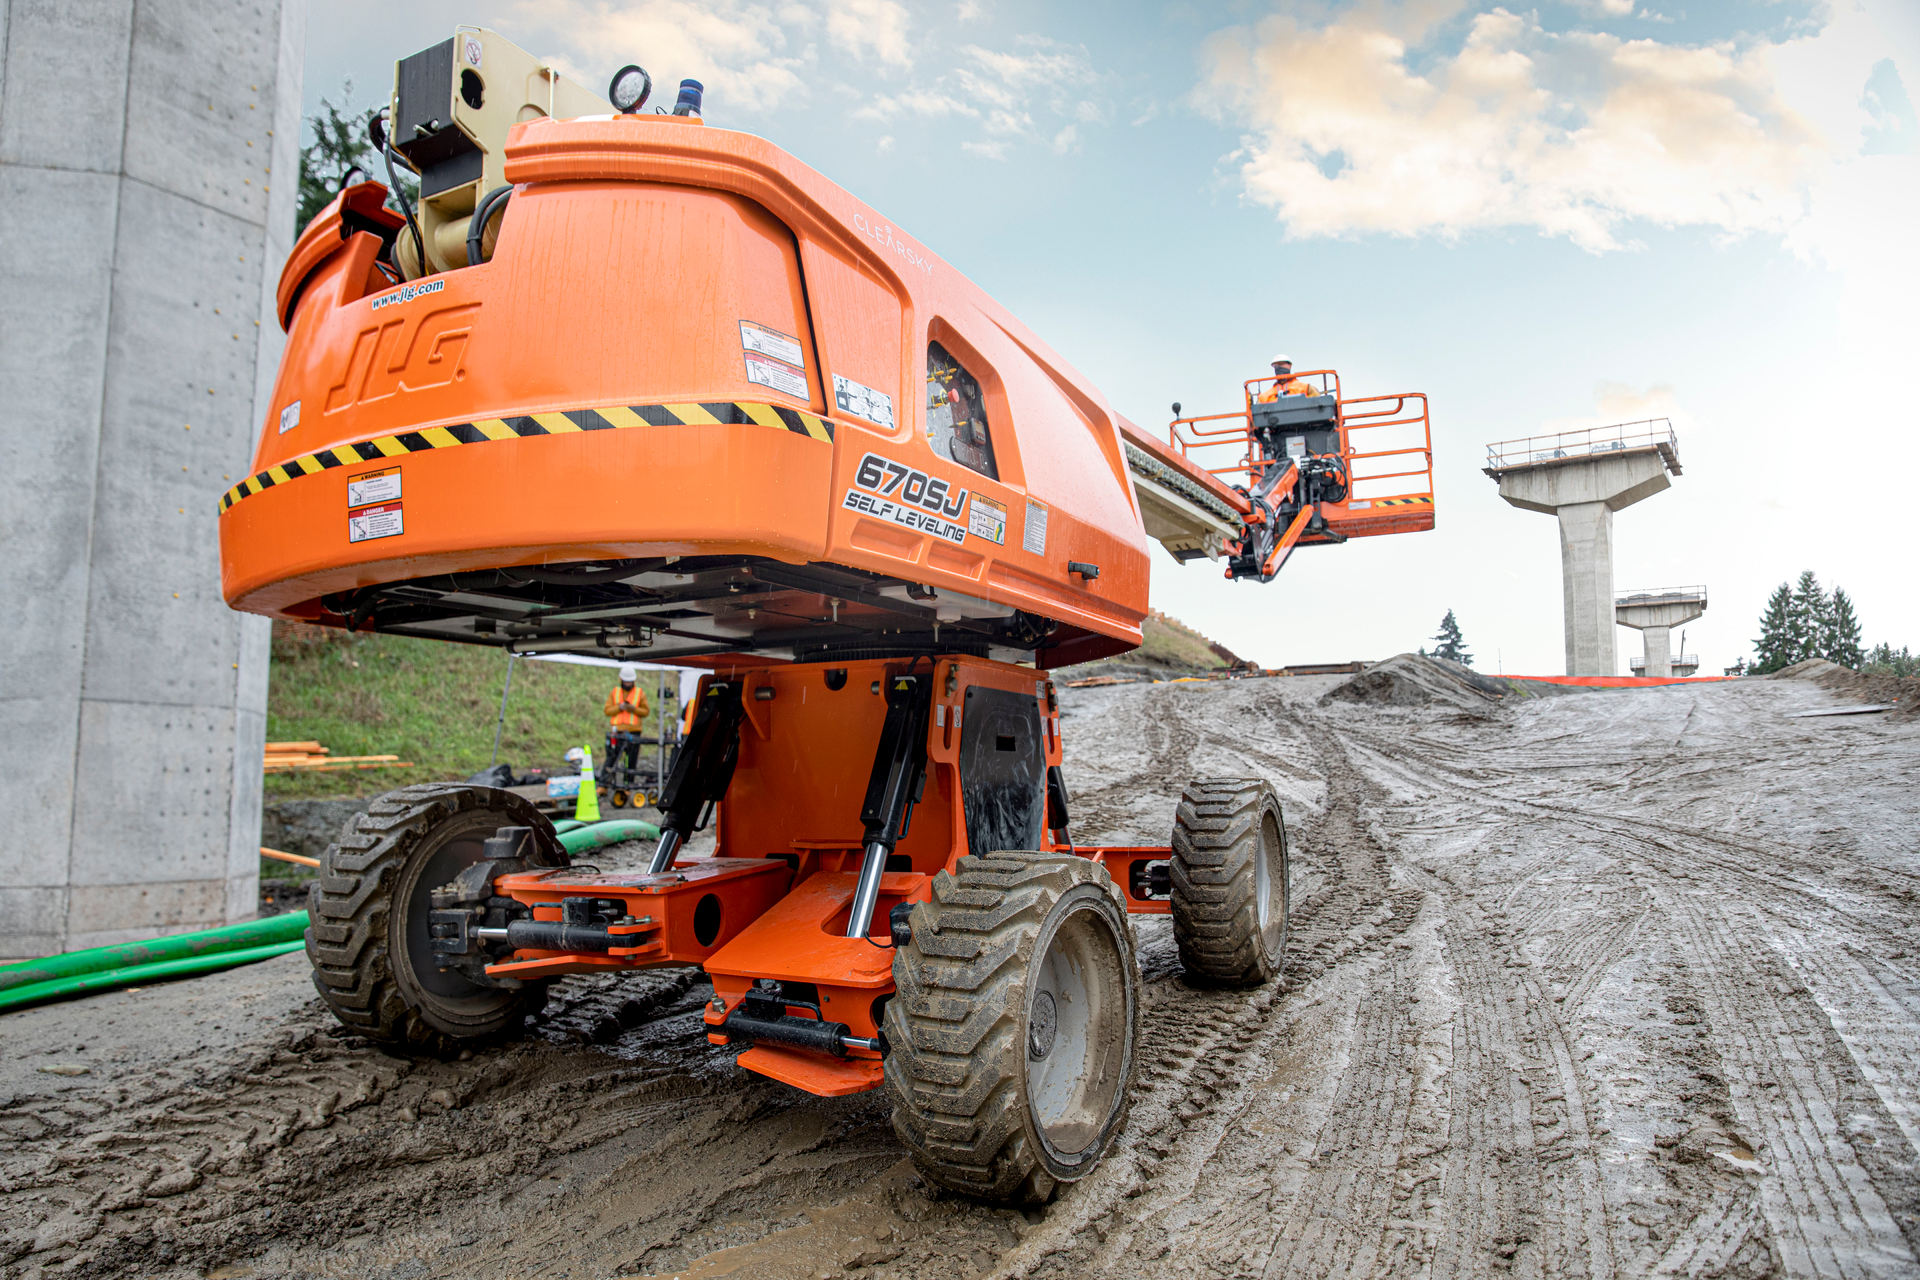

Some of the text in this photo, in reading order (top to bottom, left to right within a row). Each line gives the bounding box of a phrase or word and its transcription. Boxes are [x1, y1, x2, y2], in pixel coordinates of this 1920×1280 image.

[853, 213, 934, 276] CLEARSKY
[372, 279, 445, 309] www.jlg.com
[364, 471, 385, 480] WARNING
[857, 454, 967, 518] 670SJ
[845, 492, 894, 518] SELF
[895, 507, 966, 542] LEVELING
